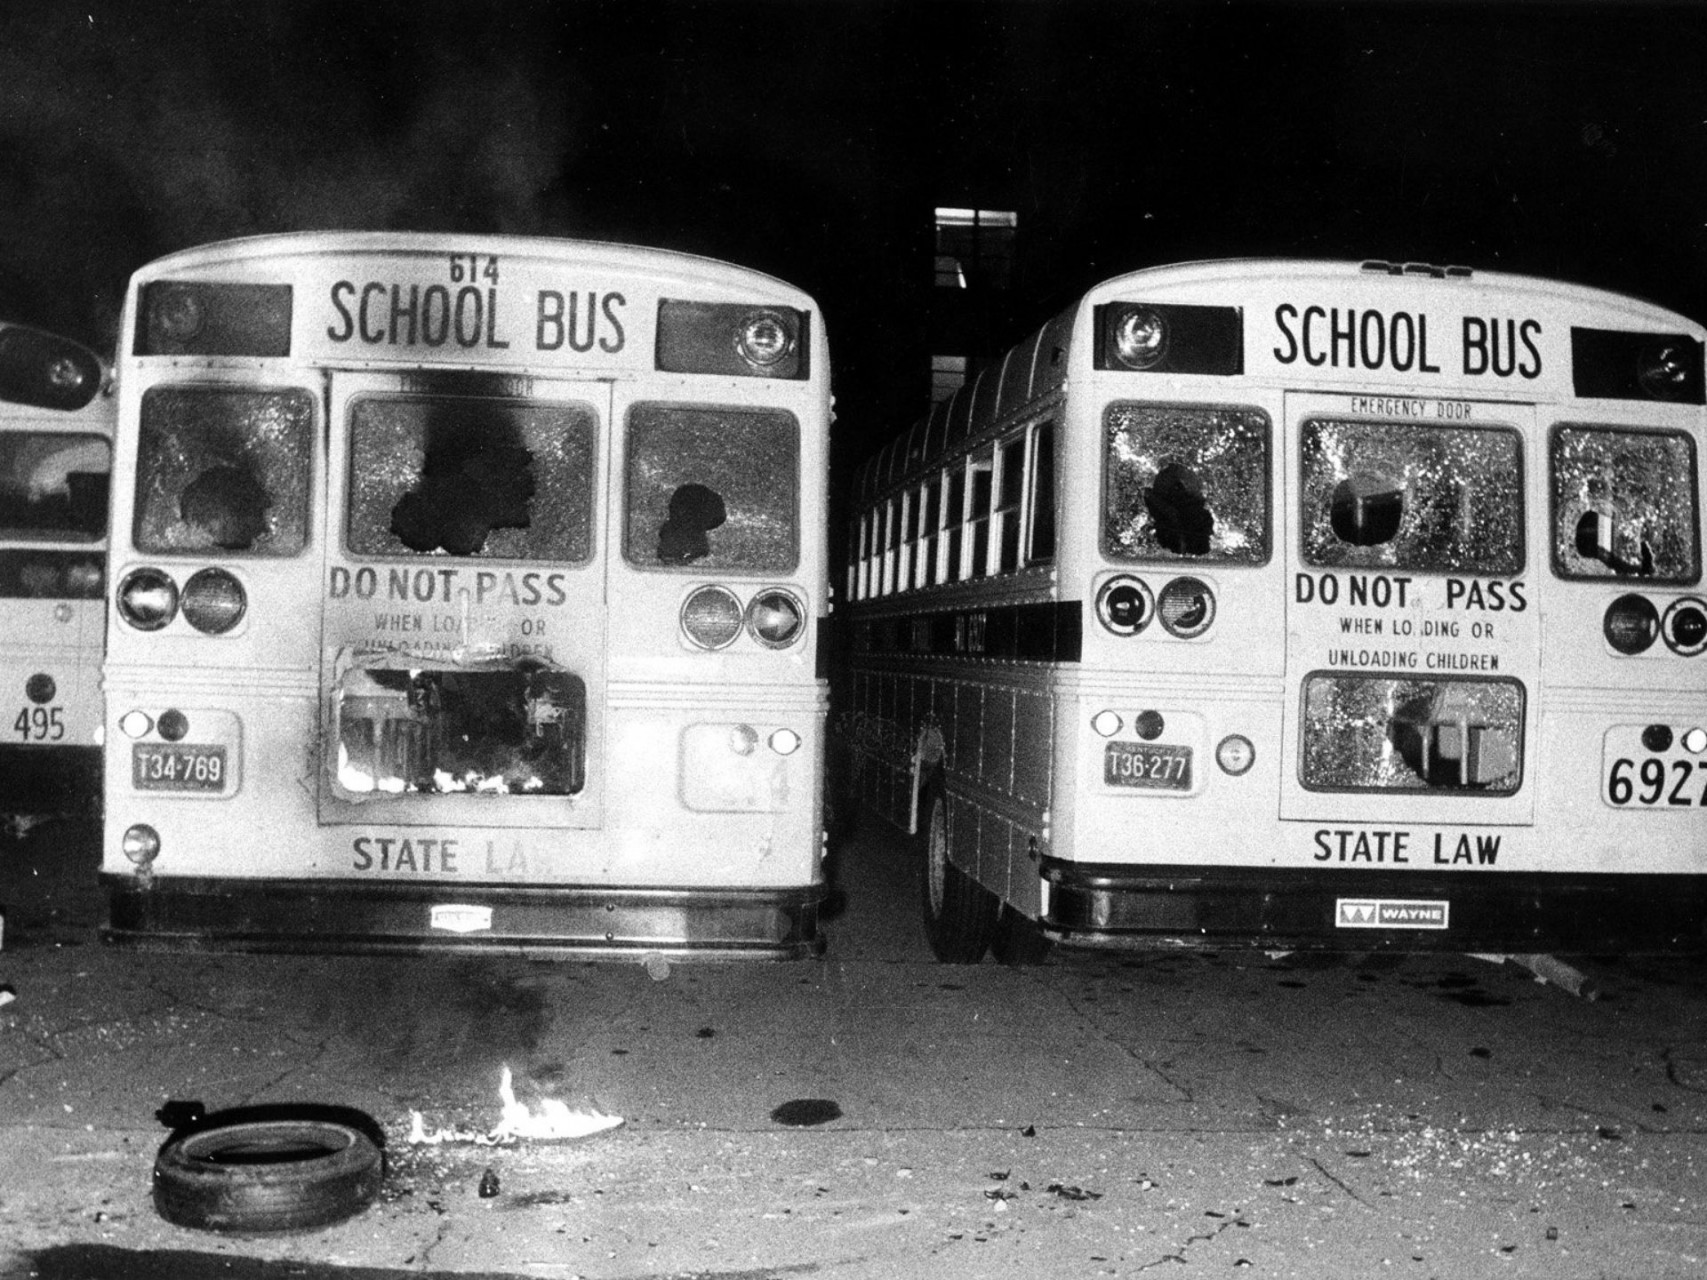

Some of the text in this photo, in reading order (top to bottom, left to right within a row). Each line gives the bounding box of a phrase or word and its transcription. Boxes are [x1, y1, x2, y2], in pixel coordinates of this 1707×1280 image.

[450, 255, 499, 285] 614
[327, 280, 626, 353] SCHOOL BUS
[1273, 303, 1542, 379] SCHOOL BUS
[1351, 398, 1472, 419] EMERGENCY DOOR
[329, 566, 566, 606] DO NOT PASS
[1296, 573, 1527, 612] DO NOT PASS
[375, 614, 422, 633] WHEN
[521, 619, 546, 636] OR
[1340, 617, 1494, 639] WHEN LODING OR
[1328, 650, 1499, 670] UNLOADING CHILDREN
[14, 706, 64, 740] 495
[353, 837, 530, 874] STATE LA
[1314, 829, 1501, 864] STATE LAW
[1381, 907, 1443, 921] WAYNE
